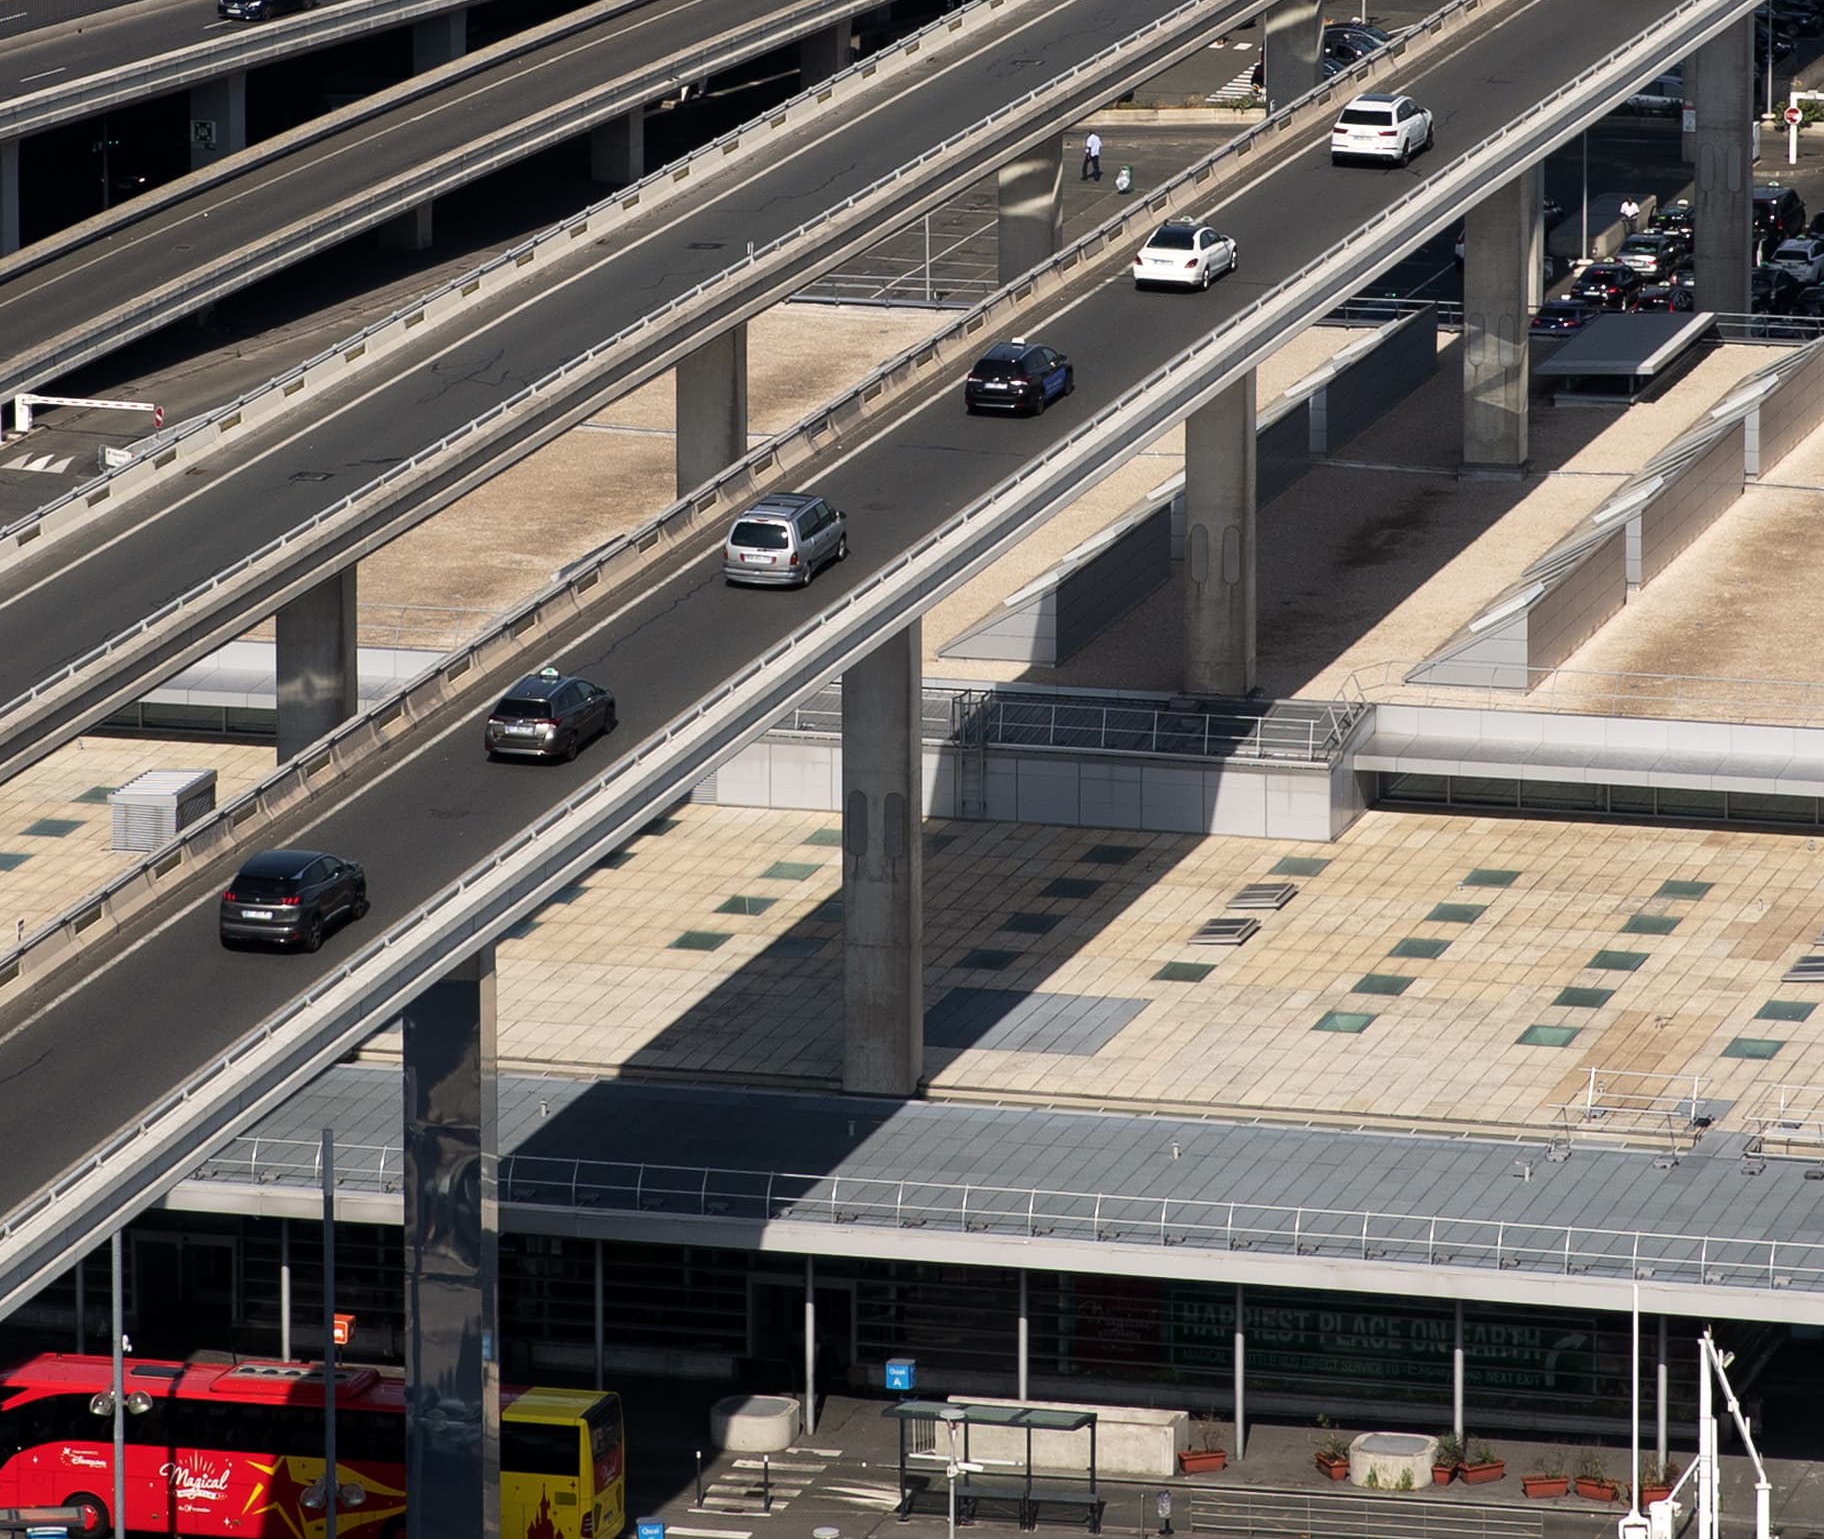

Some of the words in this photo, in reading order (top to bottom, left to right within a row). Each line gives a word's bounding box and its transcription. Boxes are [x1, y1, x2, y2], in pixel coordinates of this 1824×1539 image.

[1318, 1312, 1403, 1352] PLACE
[1409, 1319, 1449, 1355] ON
[892, 1377, 902, 1387] A
[159, 1462, 231, 1491] Magical
